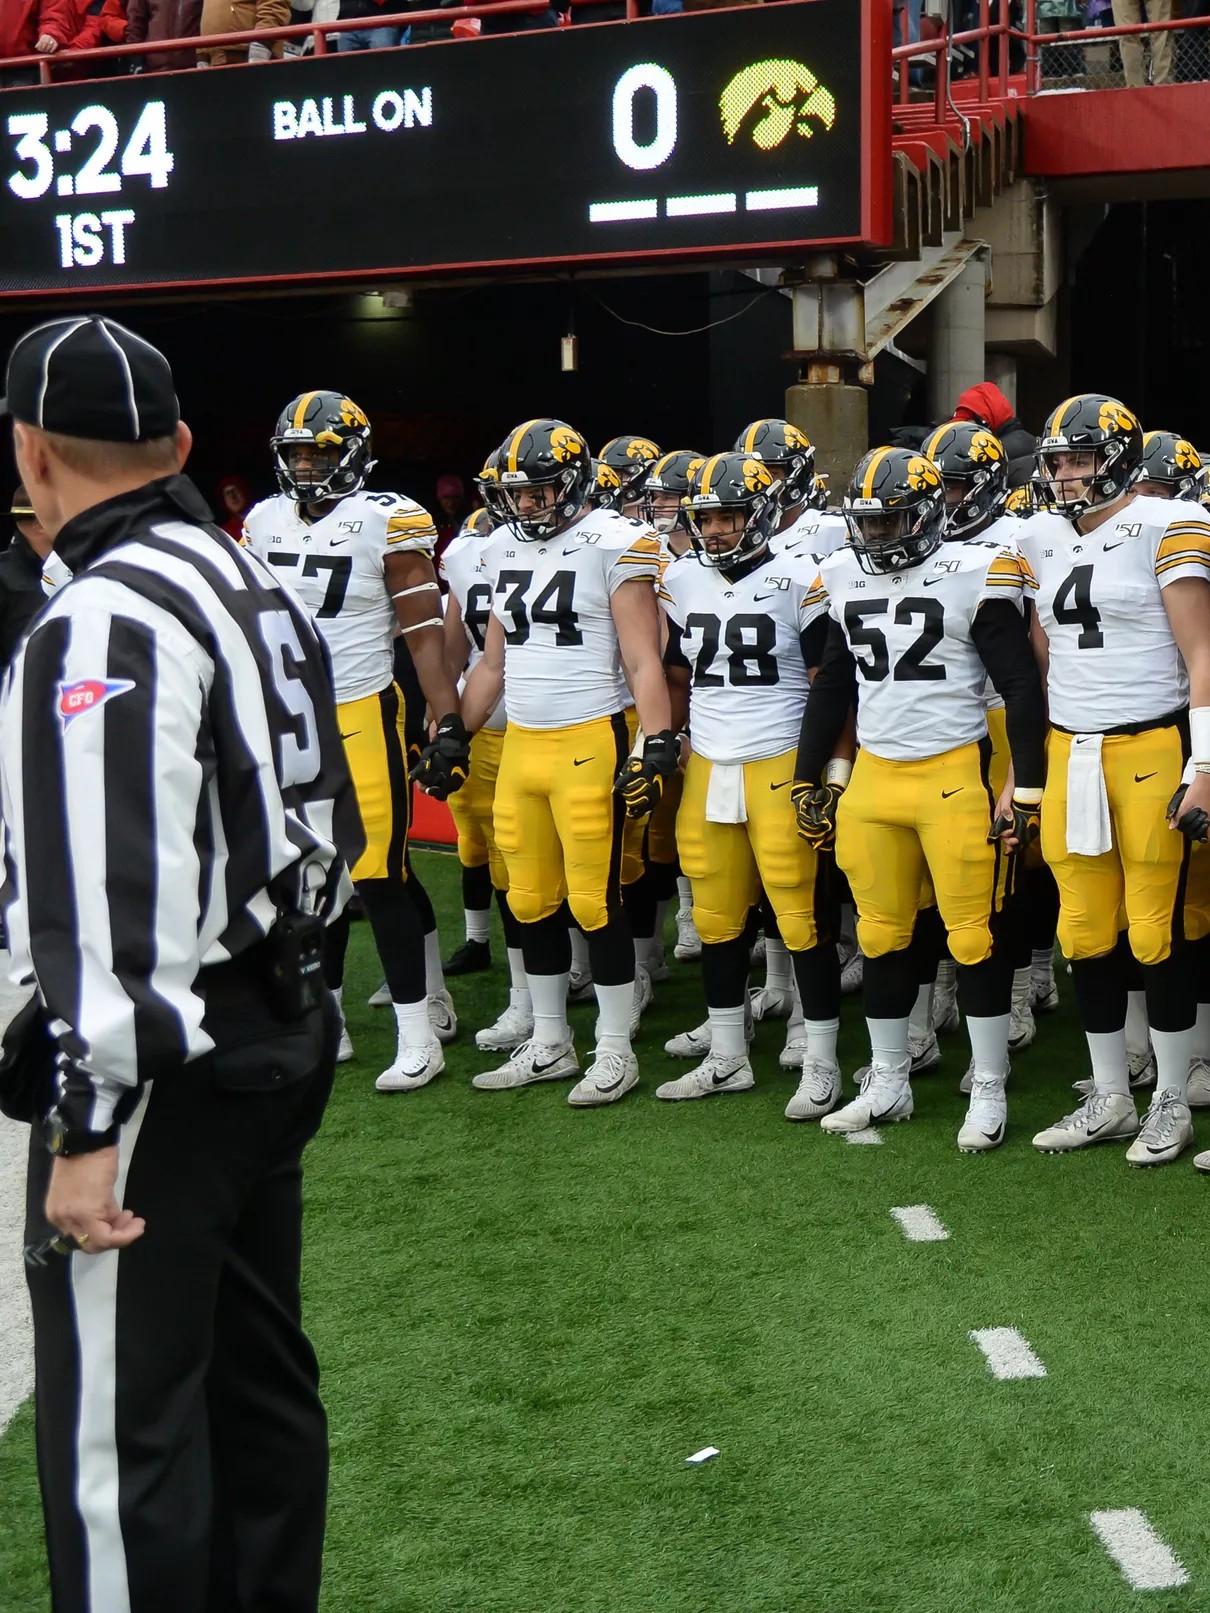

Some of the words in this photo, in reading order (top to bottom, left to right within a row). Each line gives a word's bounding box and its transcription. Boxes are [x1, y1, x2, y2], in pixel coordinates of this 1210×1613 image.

[8, 100, 175, 199] 3:24
[273, 95, 367, 140] BALL
[372, 87, 433, 132] ON
[612, 62, 678, 171] 0
[55, 209, 136, 268] 1ST
[496, 570, 583, 646] 34
[684, 612, 780, 687] 28
[843, 597, 947, 682] 52
[1052, 564, 1104, 650] 4
[258, 610, 321, 789] S
